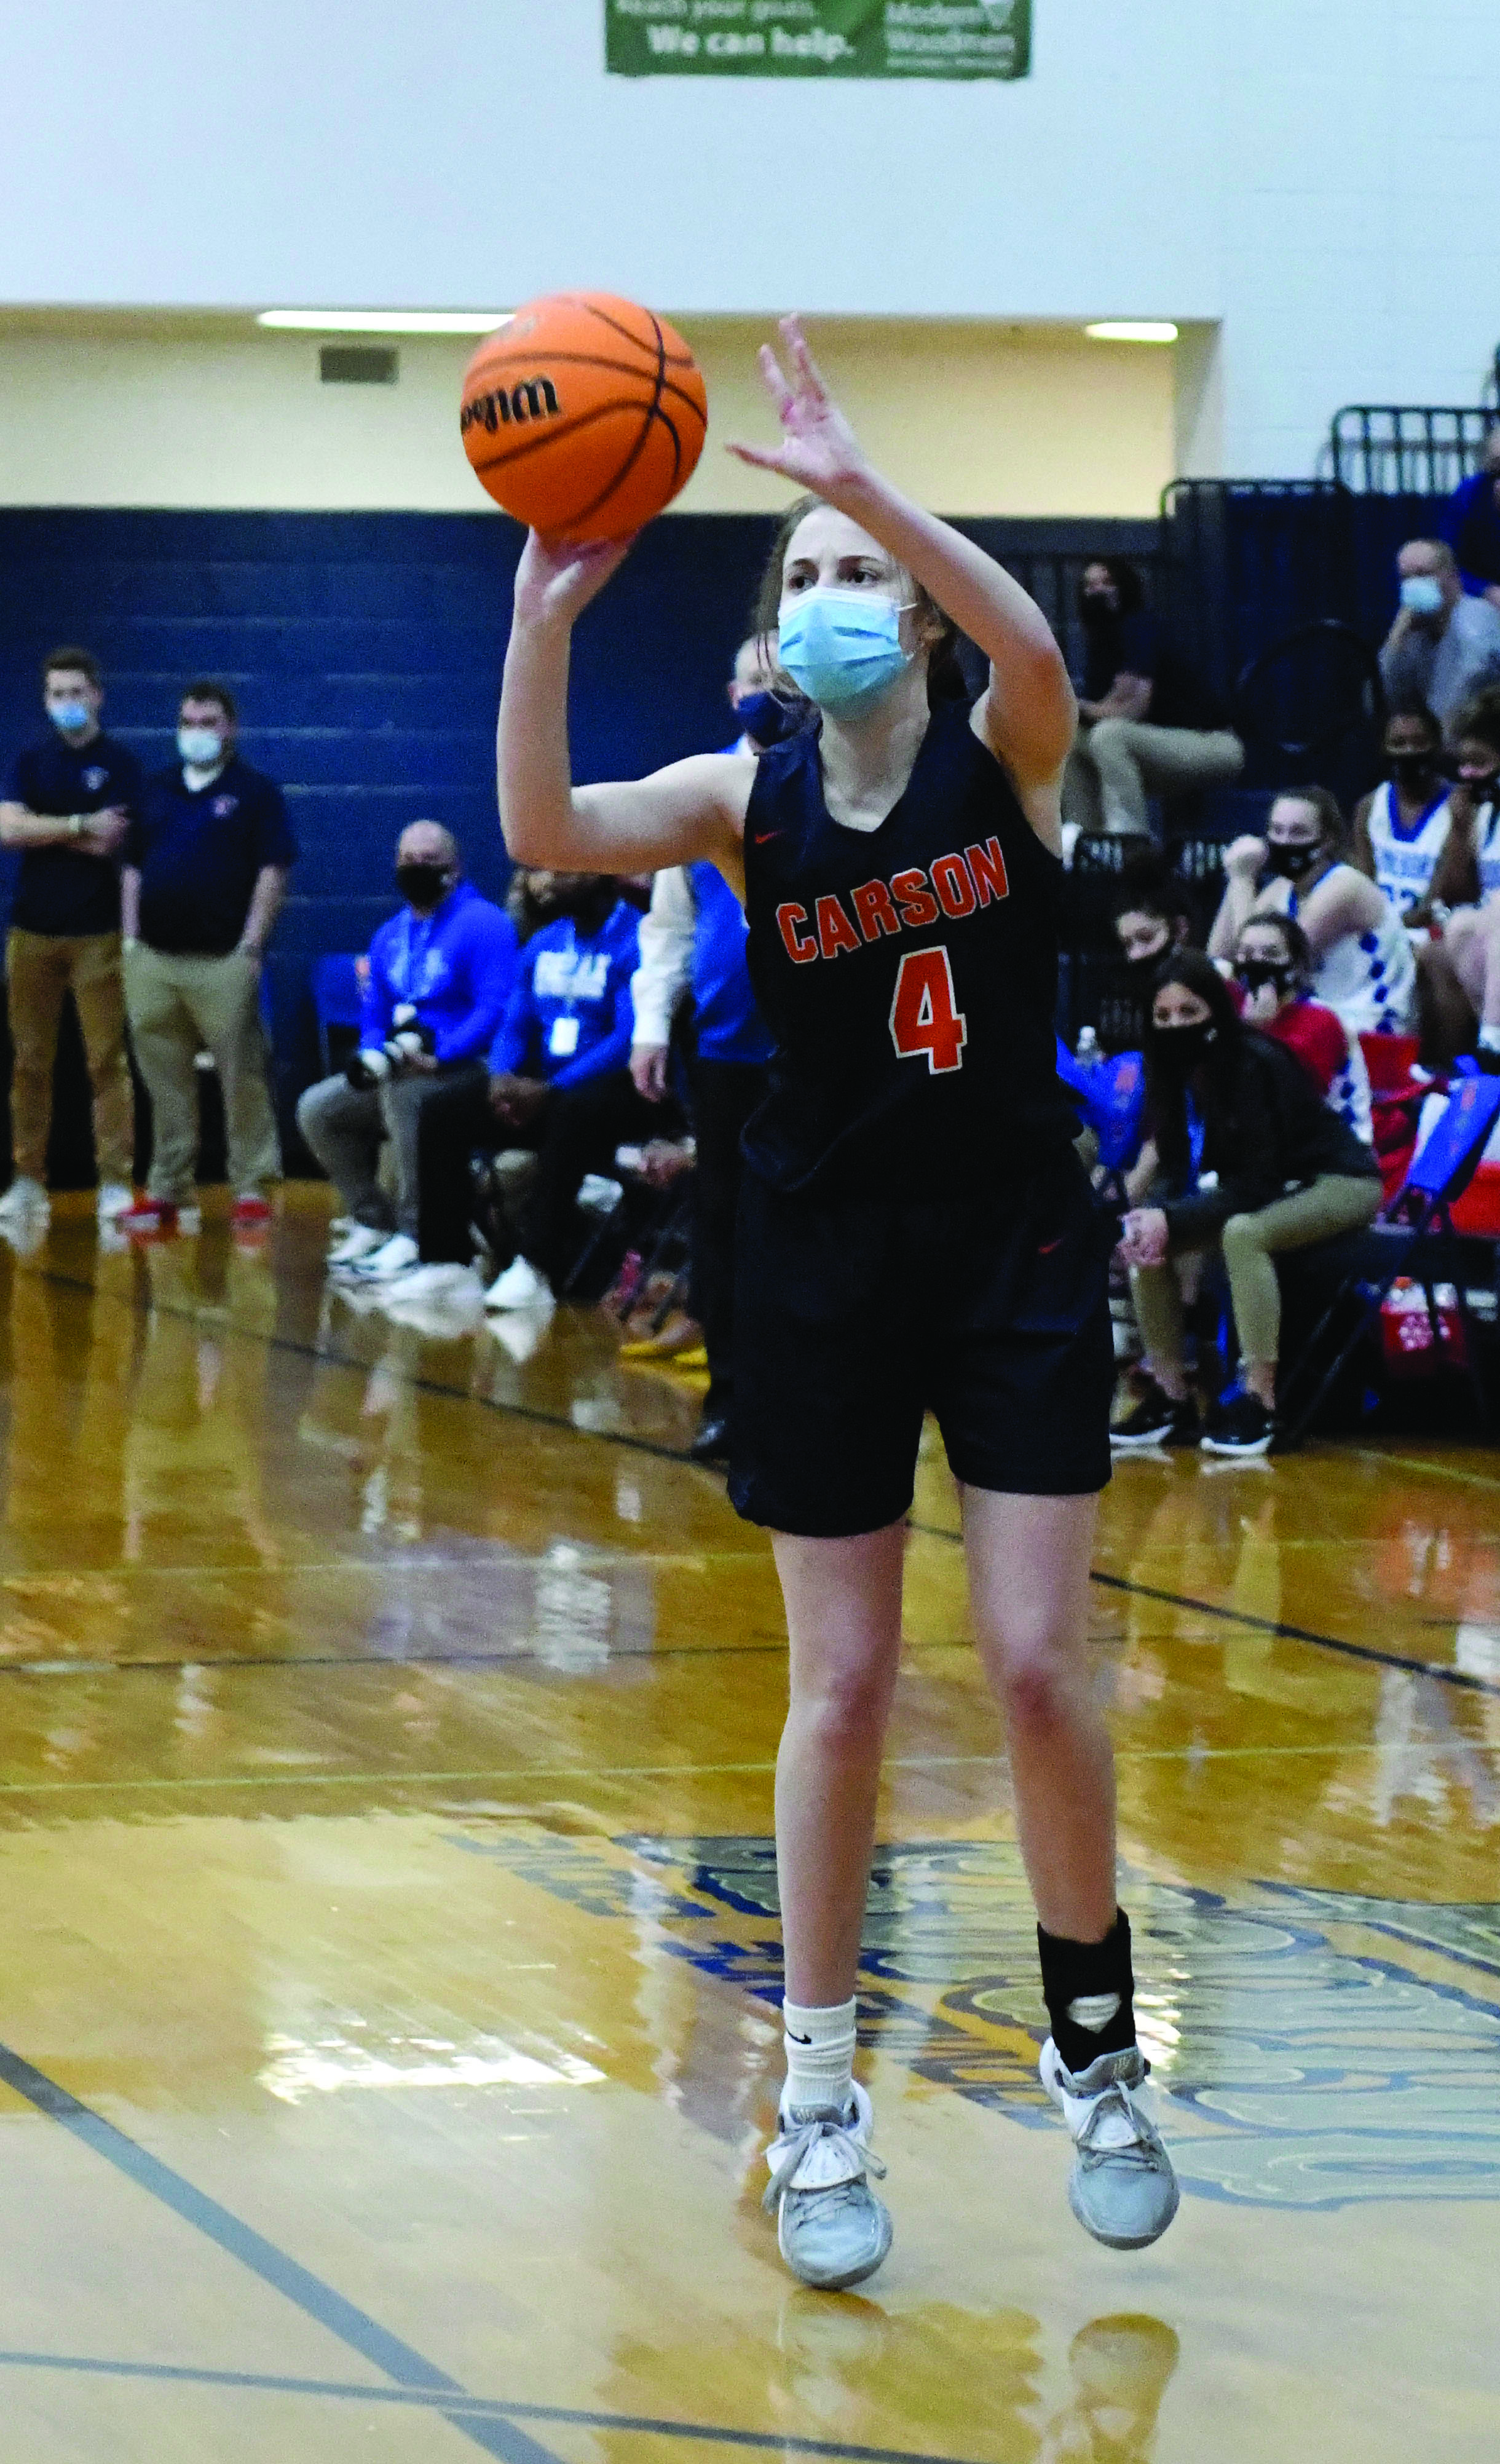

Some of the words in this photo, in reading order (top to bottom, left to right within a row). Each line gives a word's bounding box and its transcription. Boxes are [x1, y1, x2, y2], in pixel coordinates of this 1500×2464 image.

[647, 25, 699, 55] We
[706, 32, 764, 55] can
[772, 26, 855, 62] help.
[776, 835, 1009, 963] CARSON
[889, 945, 967, 1075] 4
